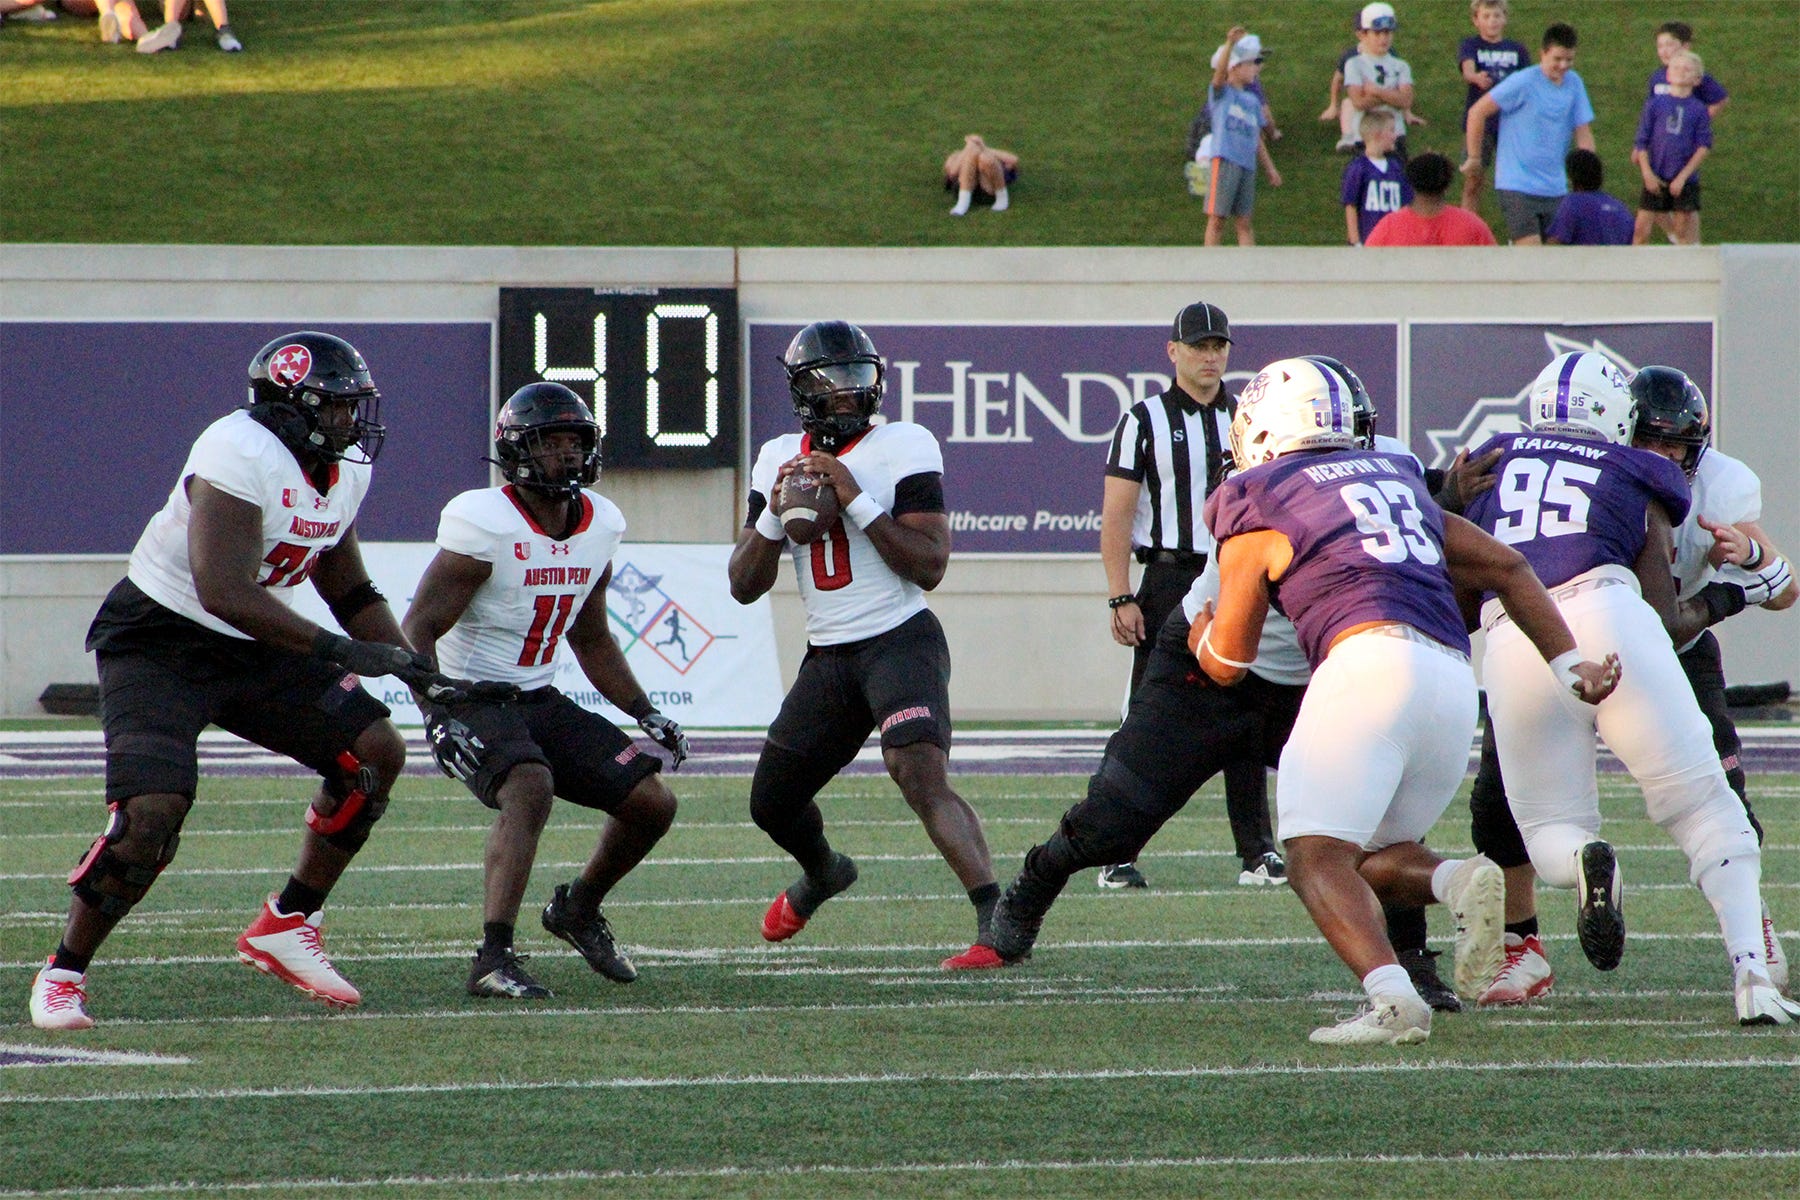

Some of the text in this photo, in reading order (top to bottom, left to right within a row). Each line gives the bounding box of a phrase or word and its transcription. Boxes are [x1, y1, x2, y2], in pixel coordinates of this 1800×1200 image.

[1365, 180, 1401, 212] ACU
[534, 304, 718, 447] 40
[1571, 396, 1585, 407] 95
[1173, 429, 1184, 442] S
[1512, 437, 1608, 460] RAUSAW
[1302, 458, 1378, 484] HERPIN
[1493, 457, 1602, 545] 95
[1340, 480, 1441, 566] 93
[523, 567, 592, 586] AUSTIN PEAY
[517, 594, 576, 667] 11
